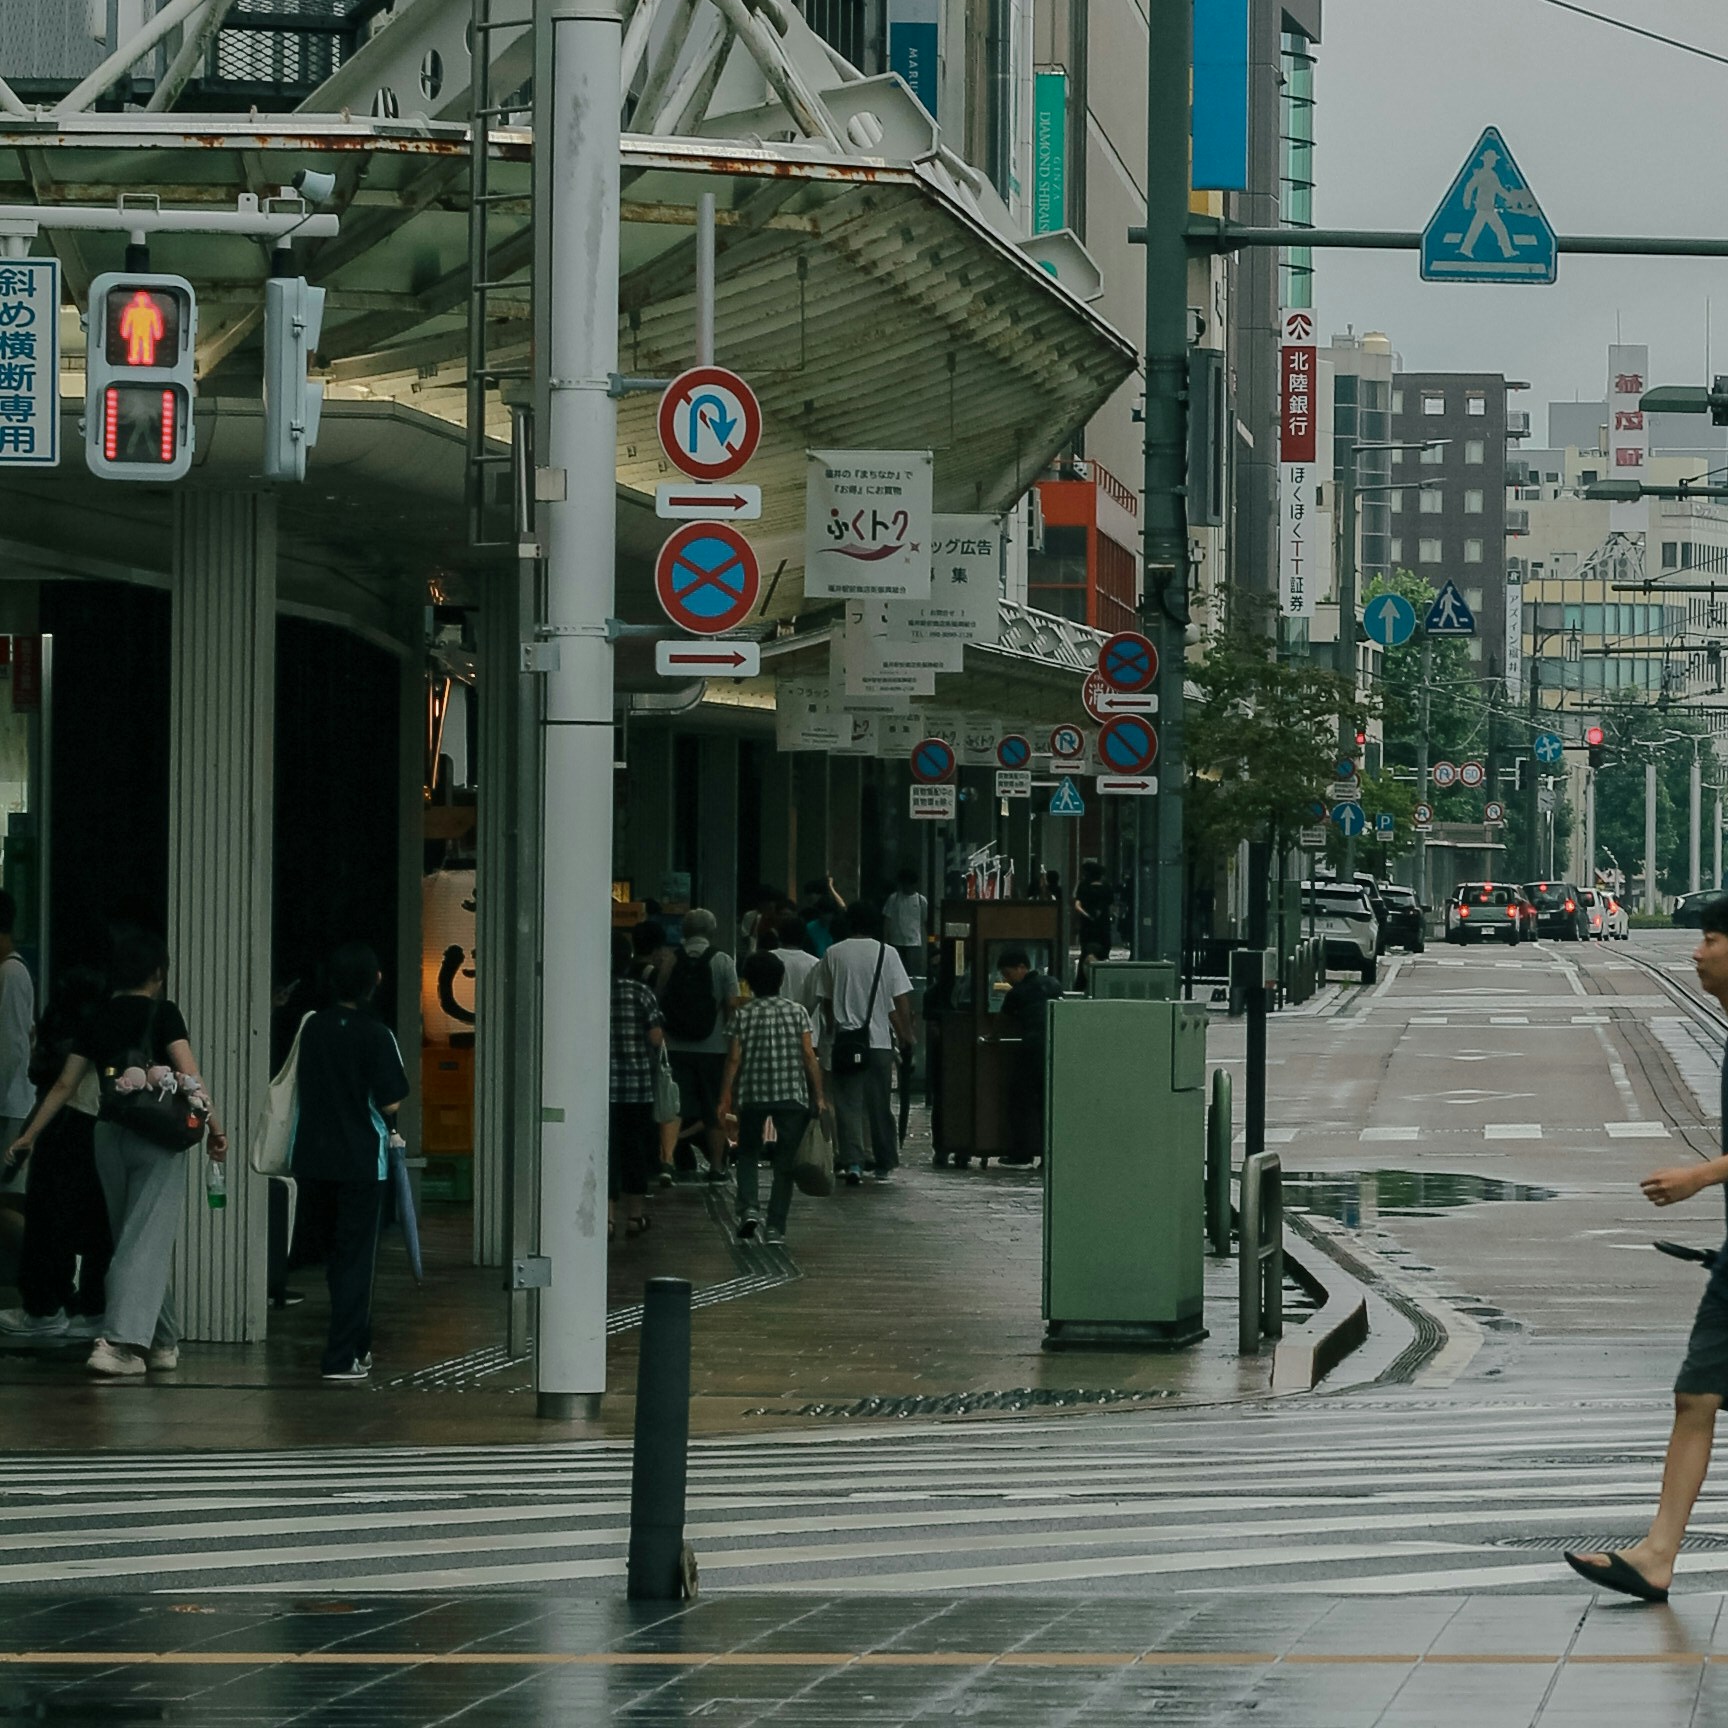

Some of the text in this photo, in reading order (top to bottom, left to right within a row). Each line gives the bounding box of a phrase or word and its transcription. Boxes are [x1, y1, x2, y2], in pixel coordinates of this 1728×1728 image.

[909, 47, 919, 95] MARU
[1039, 111, 1051, 178] DIAMOND
[1052, 156, 1061, 201] GINZA
[0, 268, 37, 454] 斜め横断専用
[1288, 351, 1308, 436] 北陸銀行
[827, 508, 908, 541] ふくトク
[1381, 816, 1390, 829] P
